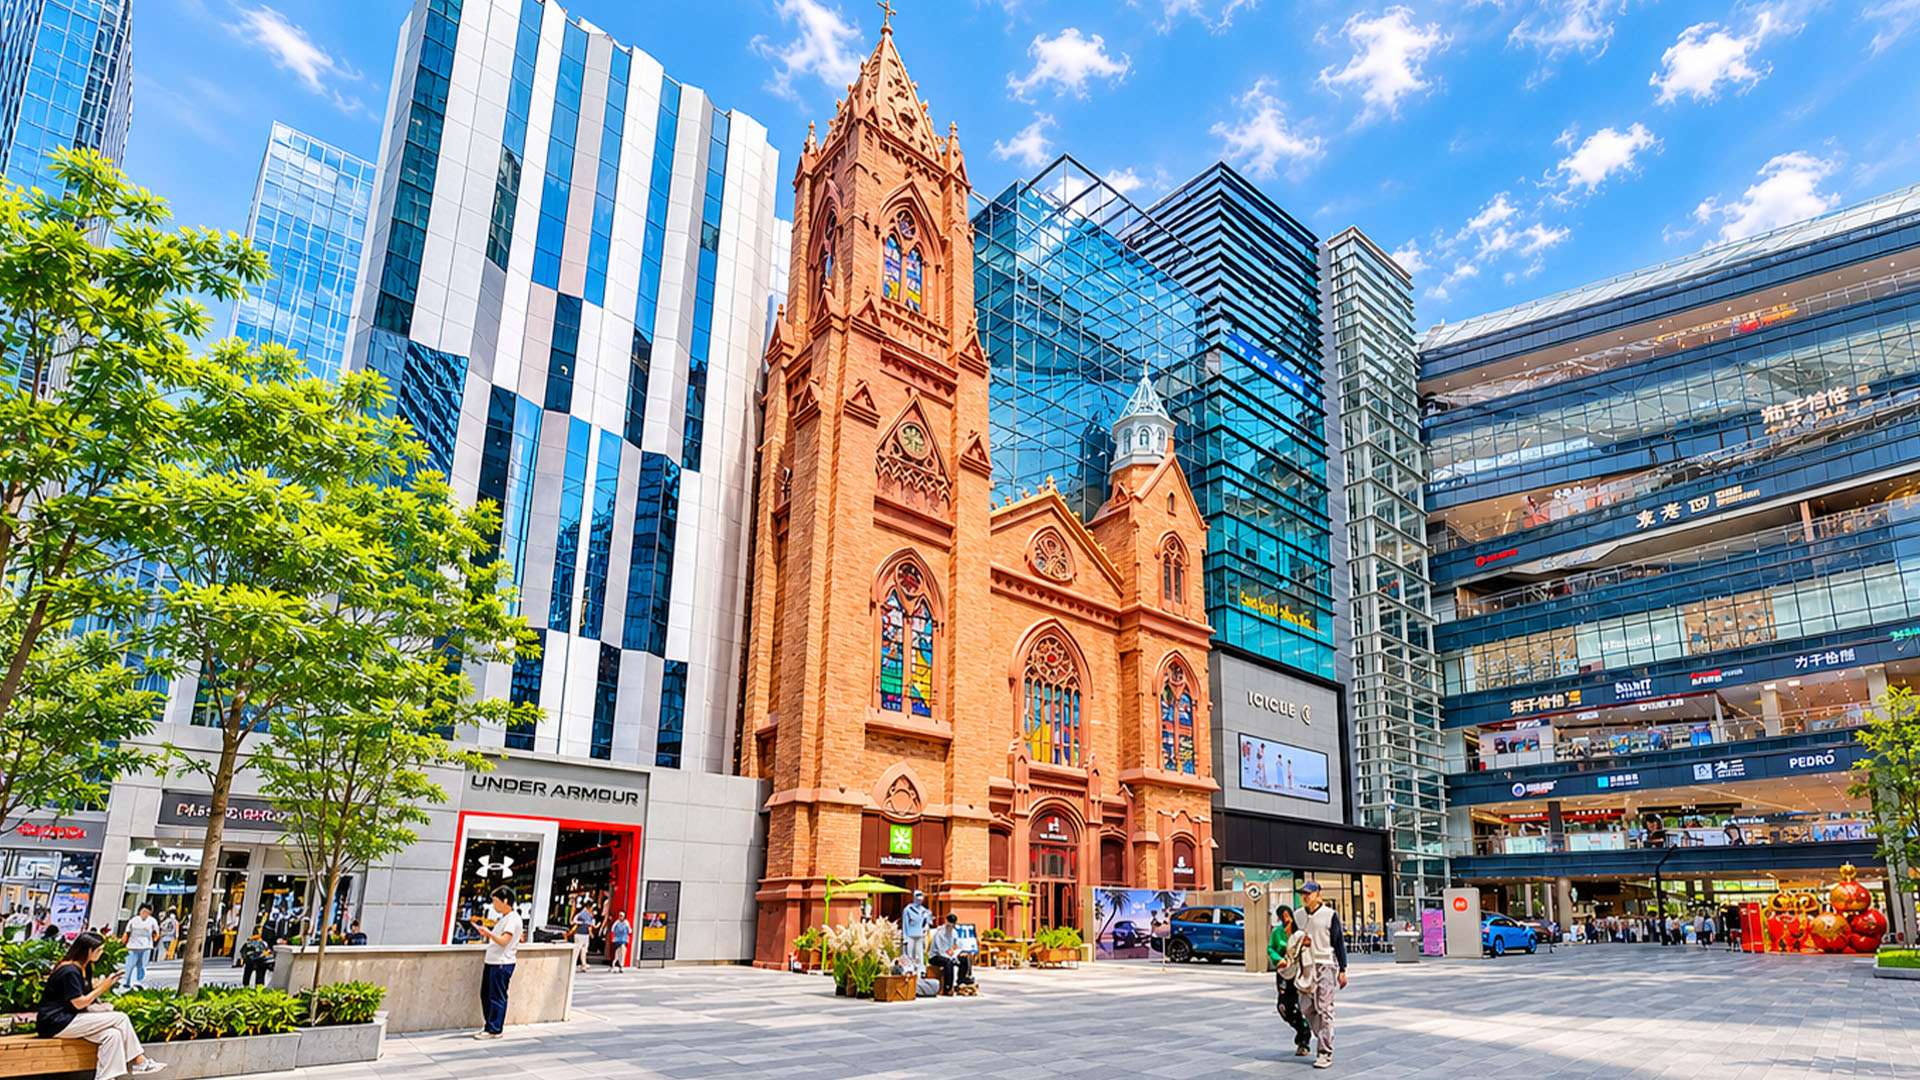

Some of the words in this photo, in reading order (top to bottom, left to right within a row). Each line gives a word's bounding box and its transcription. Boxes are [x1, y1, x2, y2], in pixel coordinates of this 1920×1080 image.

[471, 775, 547, 795] UNDER
[550, 784, 639, 805] ARMOUR
[1308, 840, 1344, 855] ICICLE
